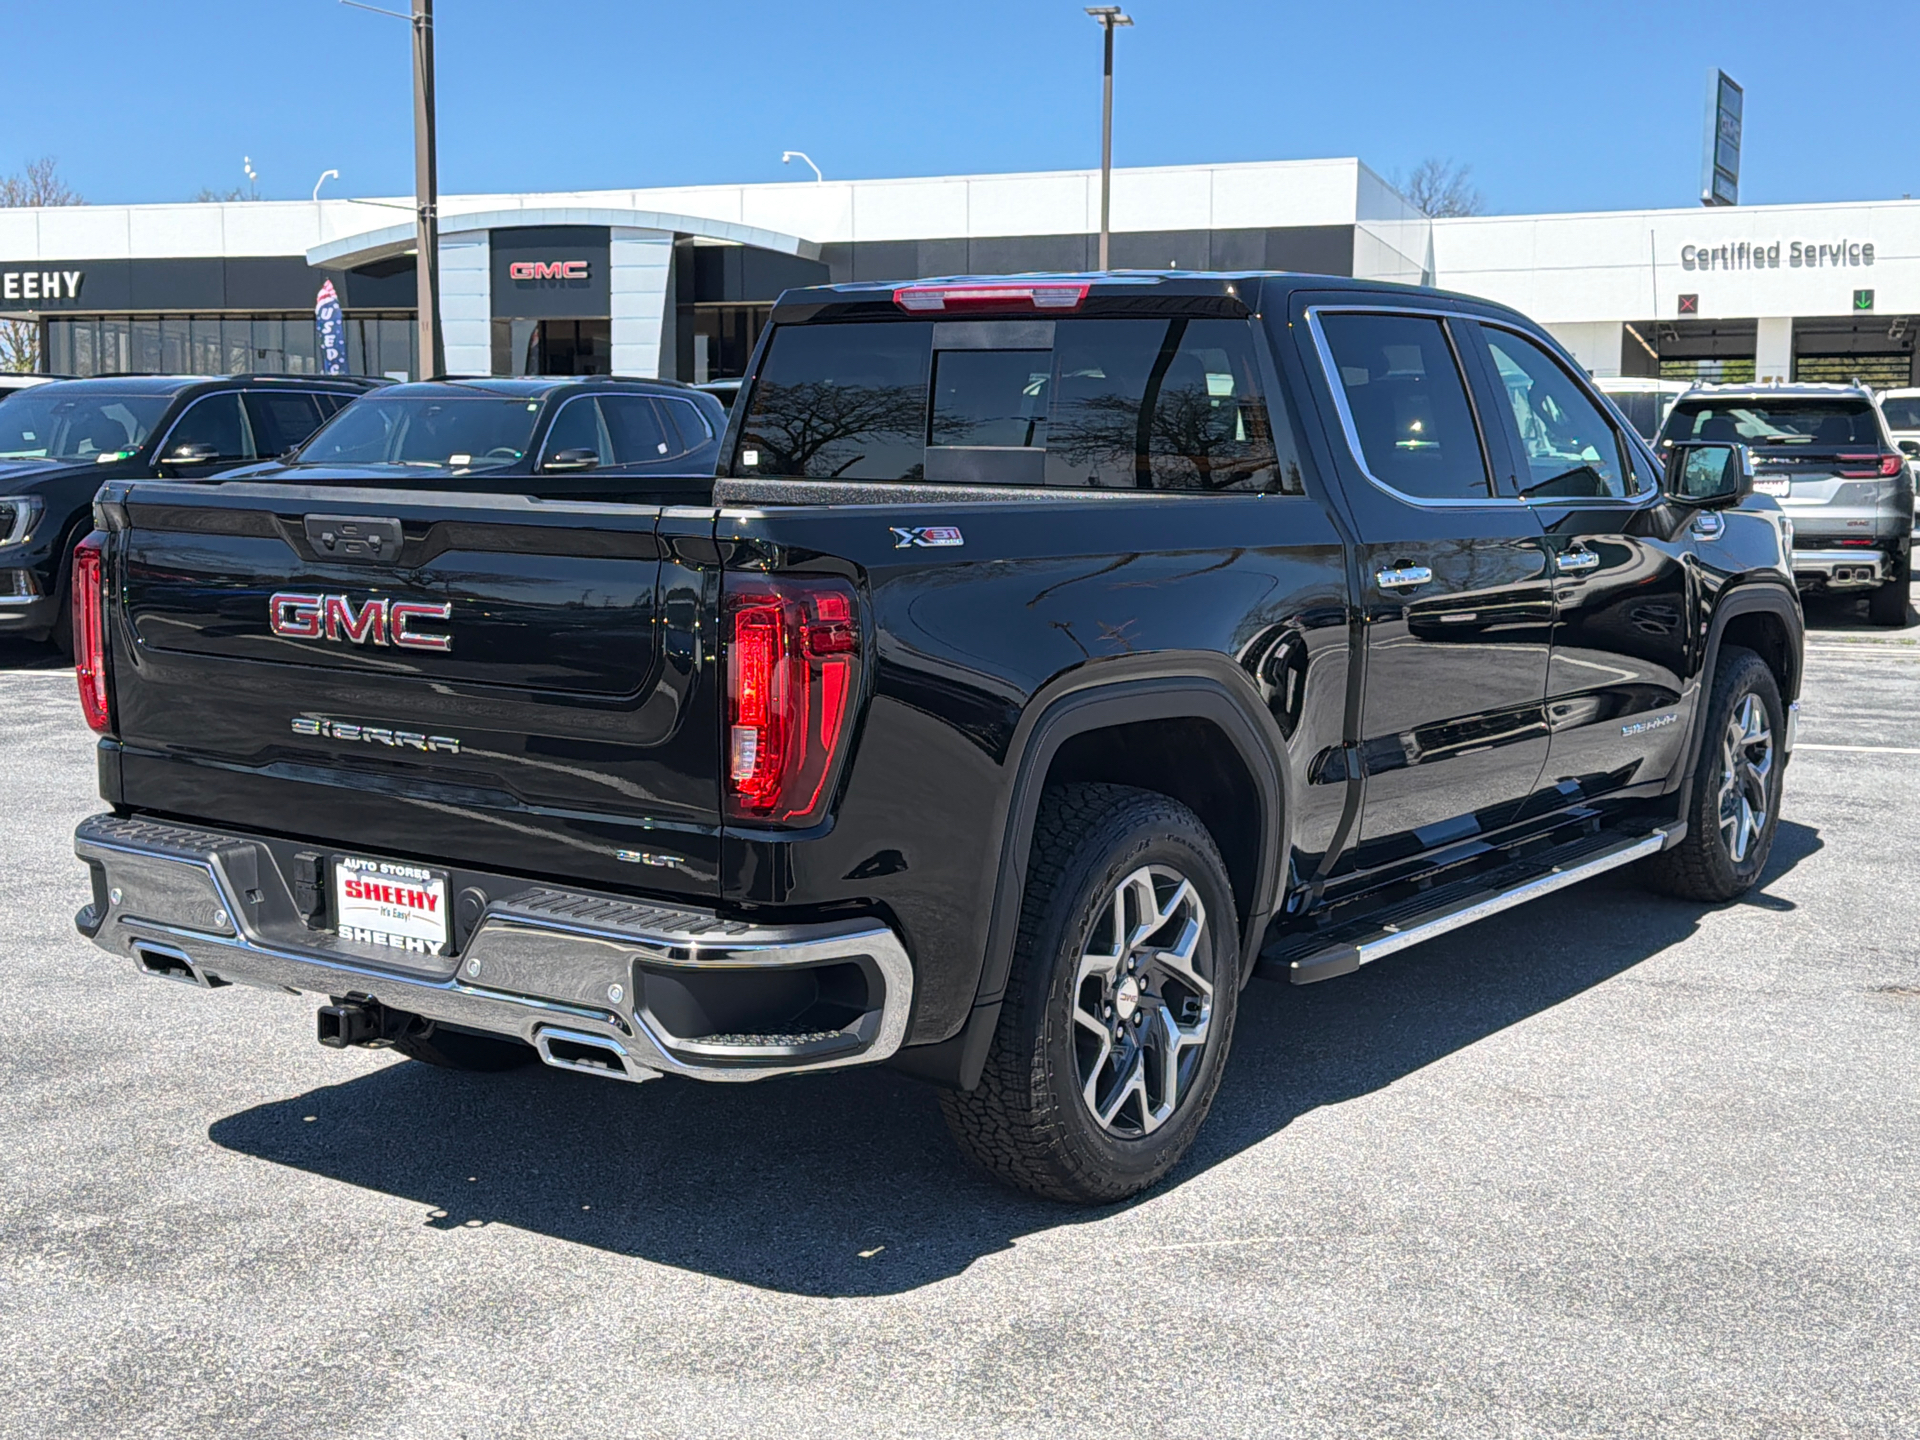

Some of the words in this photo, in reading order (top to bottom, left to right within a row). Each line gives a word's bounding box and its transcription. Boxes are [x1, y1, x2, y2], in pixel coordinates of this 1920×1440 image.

[1681, 241, 1780, 263] Certified
[1789, 238, 1875, 259] Service
[510, 261, 588, 279] GMC
[3, 271, 81, 299] EEHY
[321, 307, 339, 361] USED
[269, 592, 452, 652] GMC
[291, 718, 460, 754] SIERRA
[343, 858, 377, 872] AUTO
[380, 864, 430, 879] STORES
[616, 849, 685, 868] SLT
[345, 880, 438, 912] SHEEHY
[380, 906, 391, 917] It's
[393, 908, 411, 922] Easy!
[338, 926, 445, 955] SHEEHY
